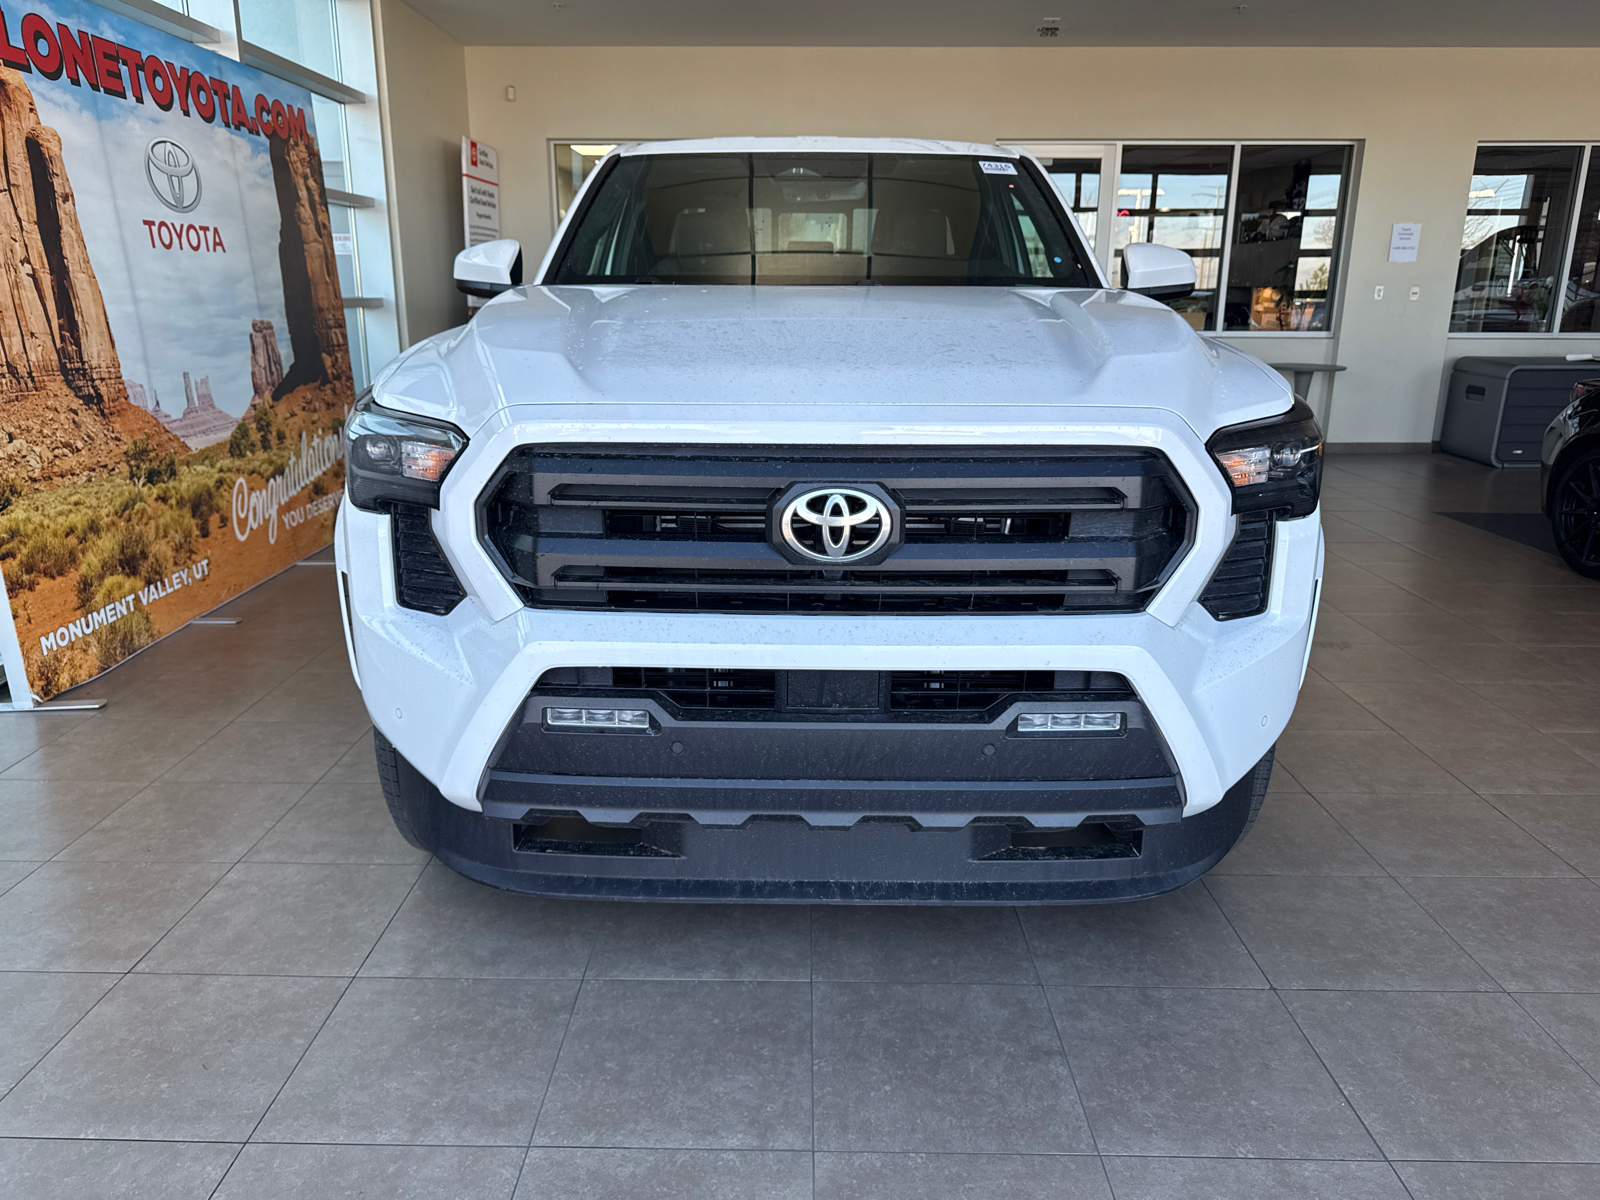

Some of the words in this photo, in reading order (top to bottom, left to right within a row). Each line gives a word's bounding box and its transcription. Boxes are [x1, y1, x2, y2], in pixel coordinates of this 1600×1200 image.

[142, 219, 227, 254] TOYOTA
[281, 506, 305, 530] YOU
[305, 488, 344, 519] DESERV
[39, 594, 136, 656] MONUMENT
[138, 569, 194, 606] VALLEY,
[191, 558, 211, 579] UT
